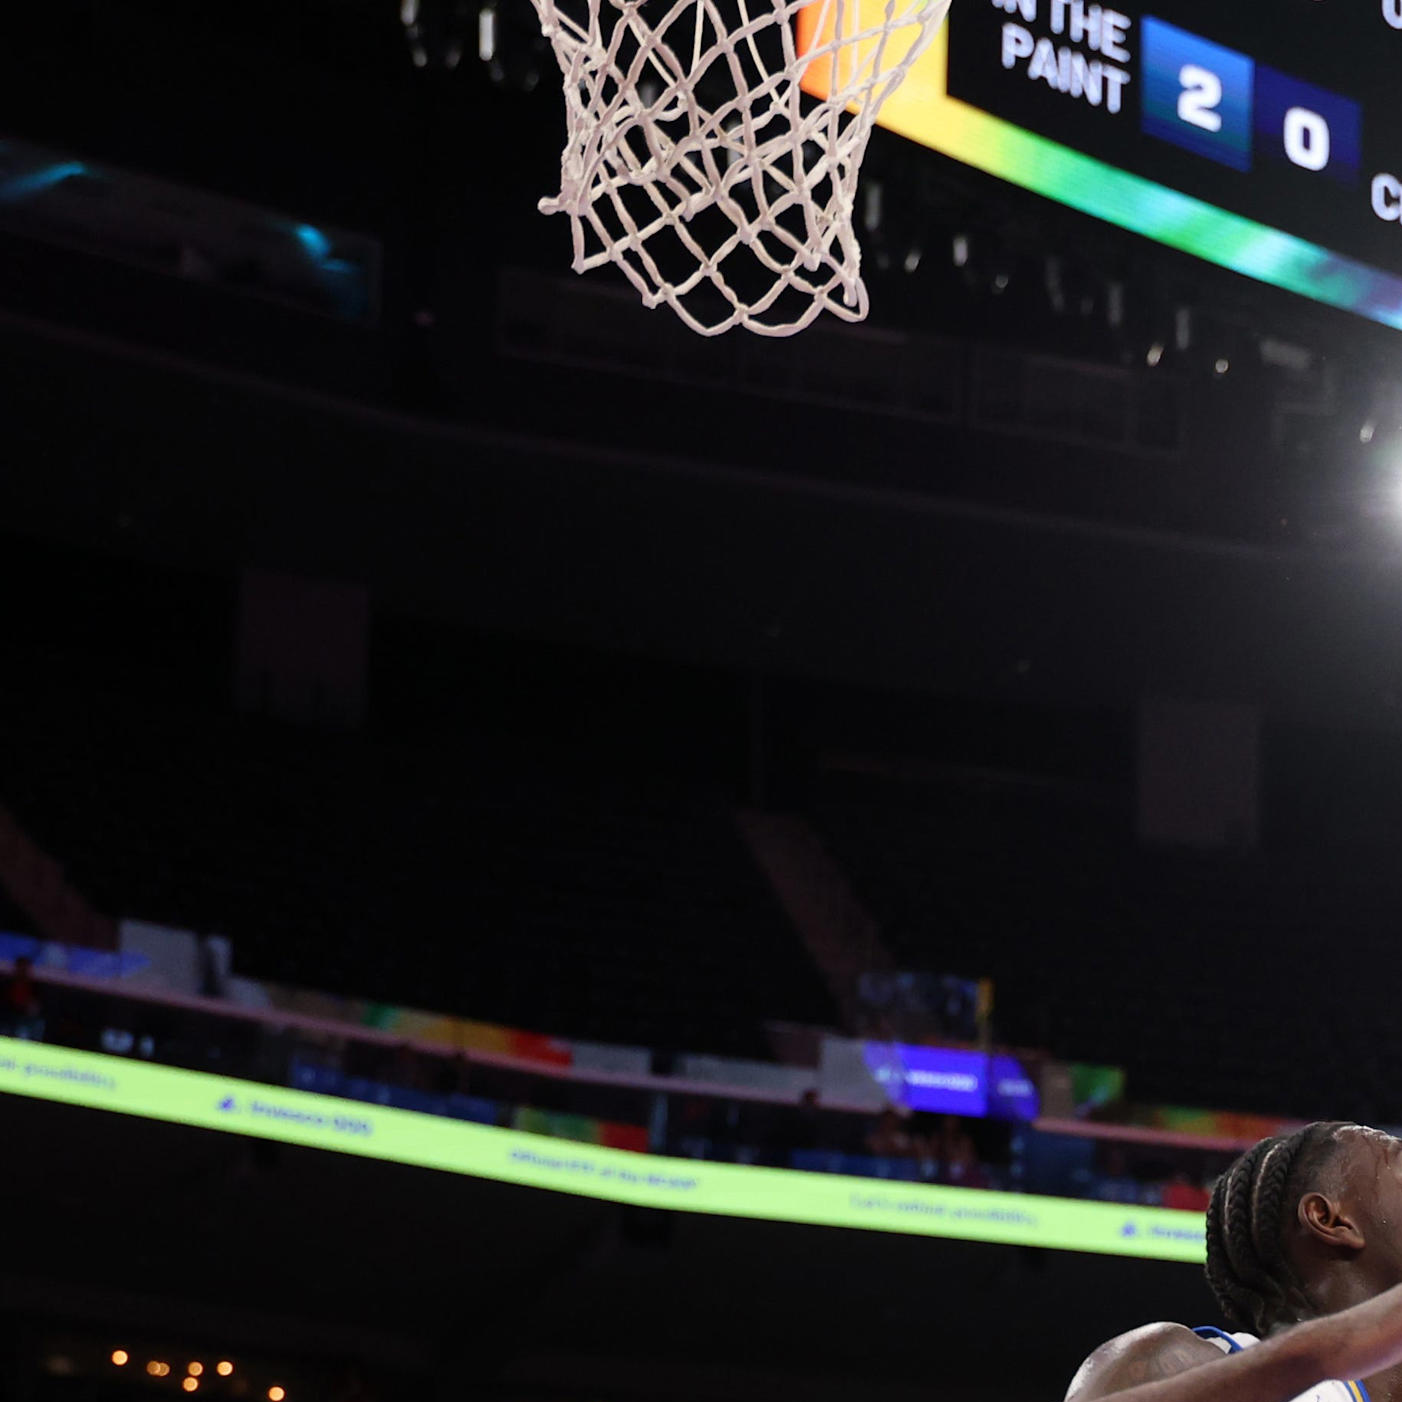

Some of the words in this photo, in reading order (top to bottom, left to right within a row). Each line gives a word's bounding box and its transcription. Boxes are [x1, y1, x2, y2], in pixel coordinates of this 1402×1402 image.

[1001, 22, 1131, 114] PAINT
[1178, 64, 1222, 131] 2
[1284, 108, 1330, 171] 0
